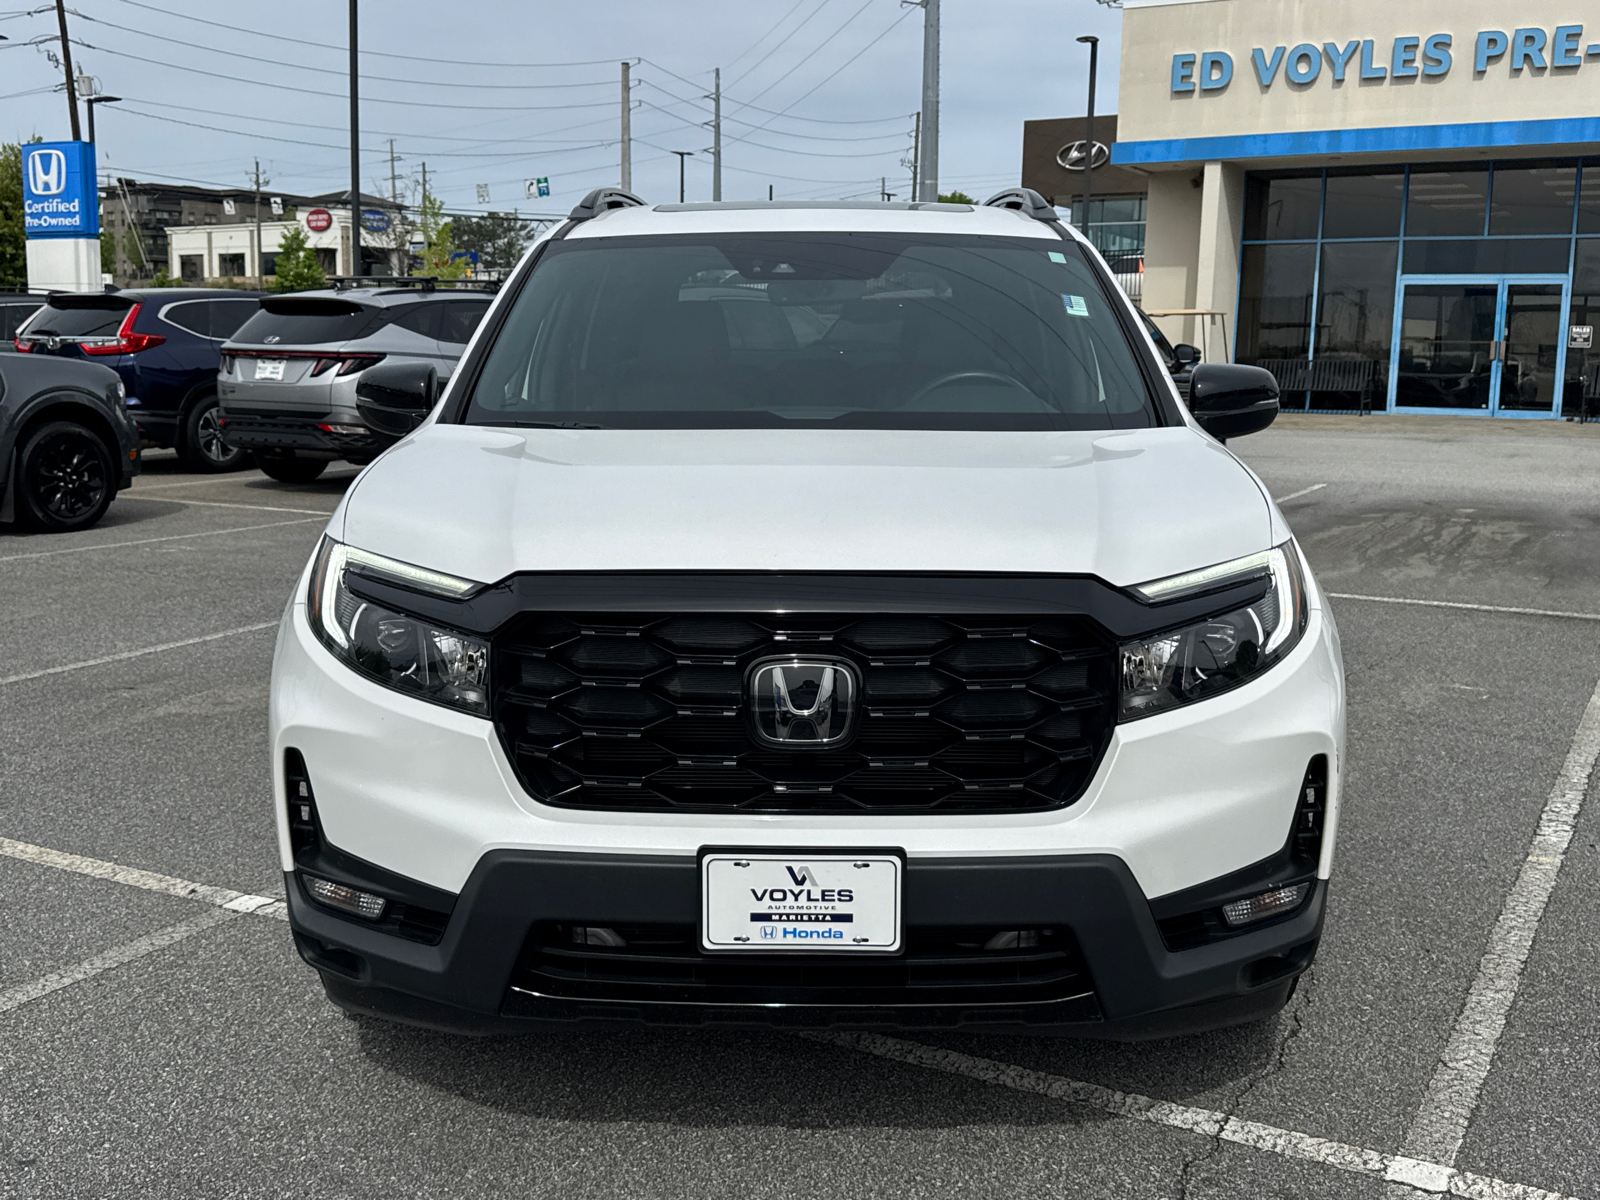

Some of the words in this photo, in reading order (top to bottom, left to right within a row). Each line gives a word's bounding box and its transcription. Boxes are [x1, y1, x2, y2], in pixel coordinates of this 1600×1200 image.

[1171, 51, 1234, 92] ED
[1252, 33, 1453, 86] VOYLES
[1475, 24, 1600, 73] PRE-
[24, 198, 79, 214] Certified
[25, 214, 80, 227] Pre-Owned
[750, 888, 854, 903] VOYLES
[782, 927, 844, 939] Honda
